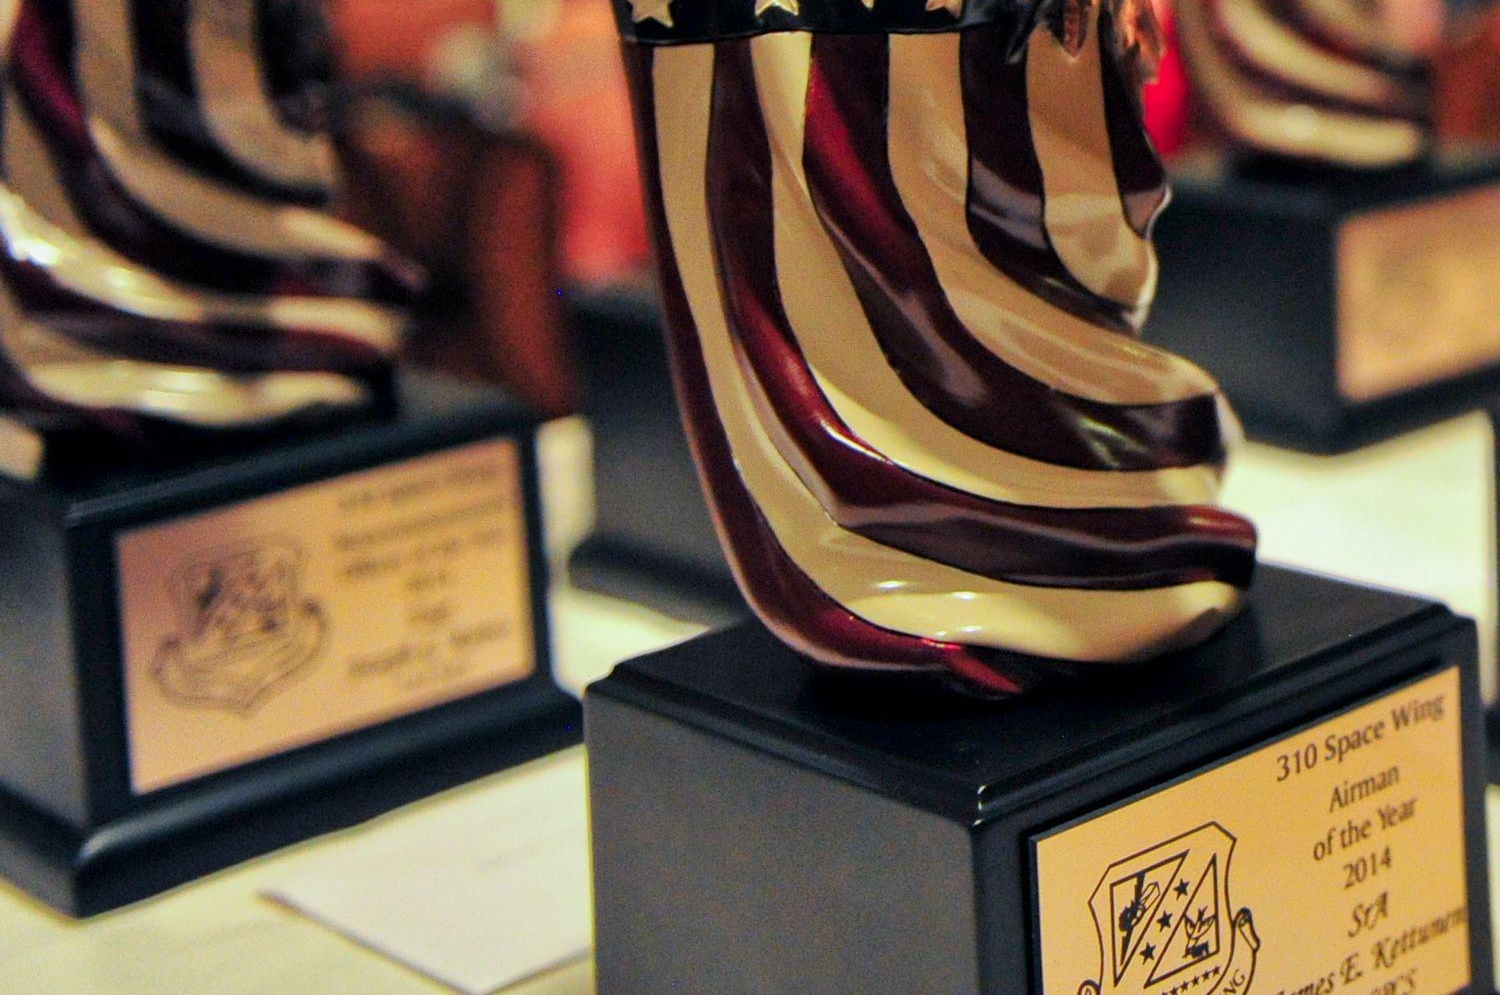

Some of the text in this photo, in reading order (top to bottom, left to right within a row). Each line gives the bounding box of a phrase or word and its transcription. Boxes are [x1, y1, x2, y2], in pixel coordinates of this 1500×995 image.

[1276, 695, 1445, 782] 310 Space Wing
[1329, 766, 1400, 814] Airman
[1313, 796, 1417, 861] of the Year
[1343, 845, 1392, 890] 2014
